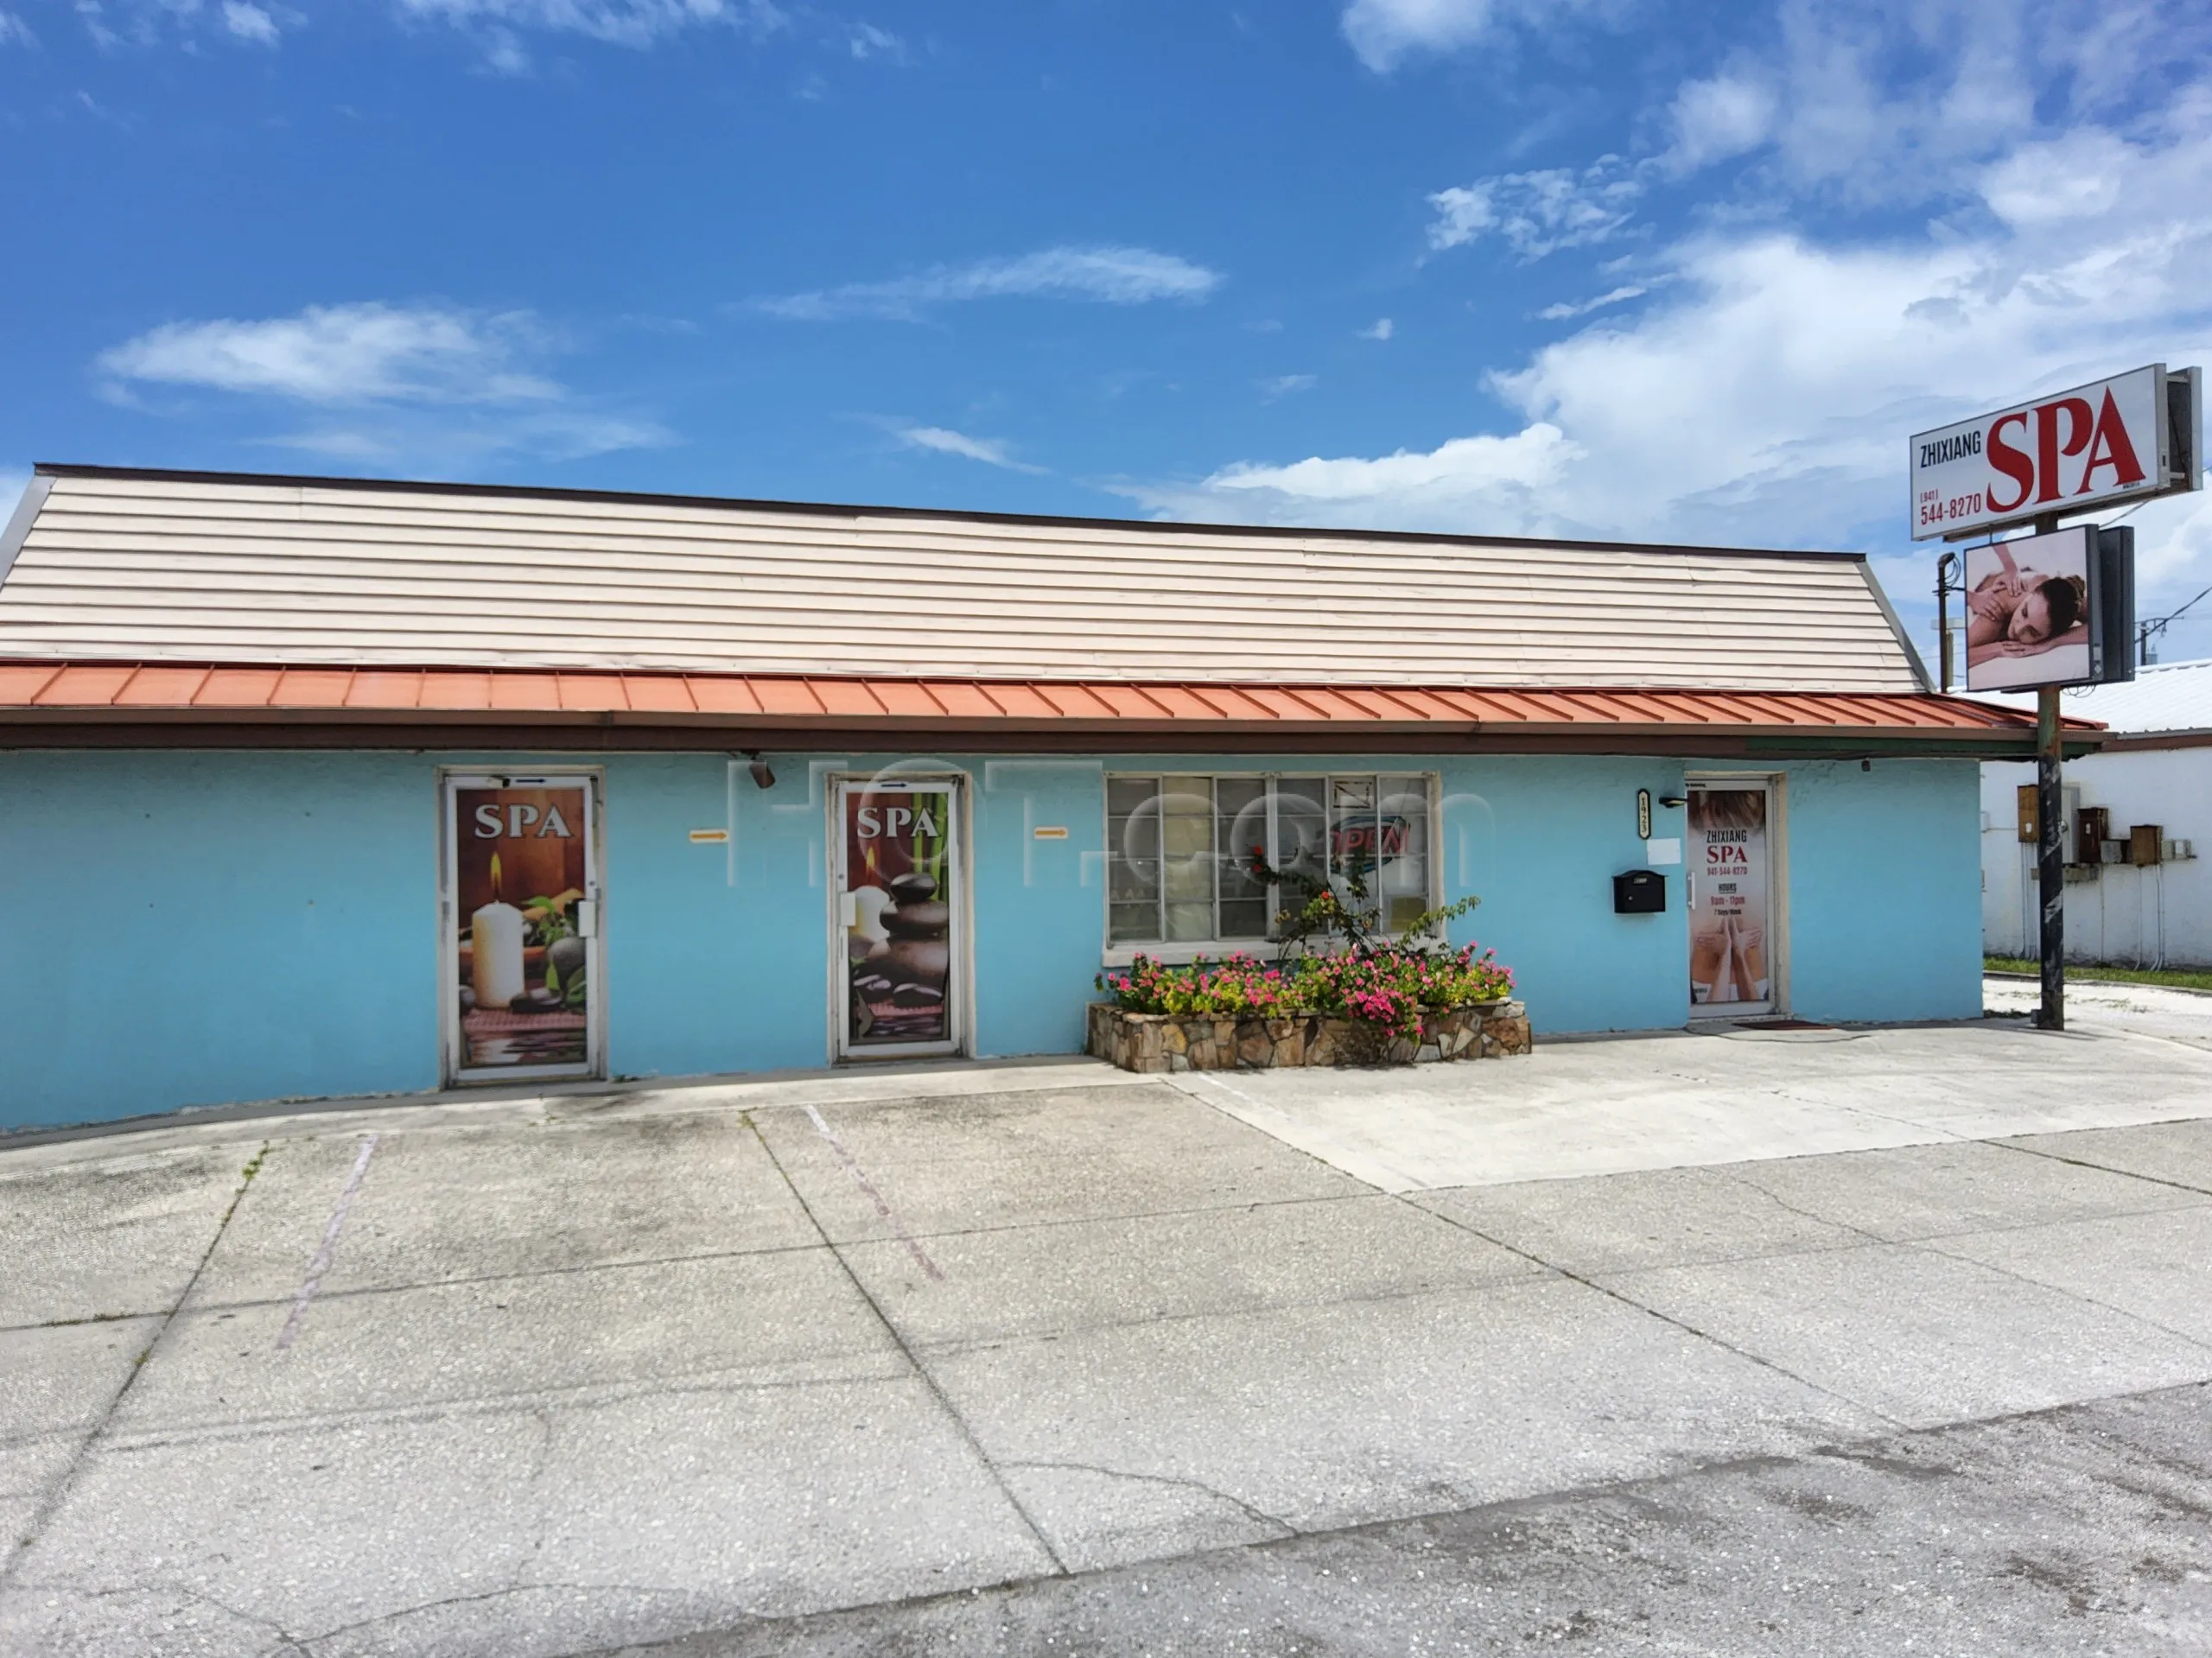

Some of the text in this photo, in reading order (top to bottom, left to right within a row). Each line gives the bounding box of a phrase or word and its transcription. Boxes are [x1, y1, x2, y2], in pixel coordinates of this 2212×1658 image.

[1920, 385, 2146, 513] ZHIXIANG SPA
[1920, 488, 1938, 504] (941)
[1921, 492, 1981, 525] 544-8270
[474, 804, 572, 839] SPA
[856, 806, 939, 839] SPA
[1707, 829, 1747, 843] ZHIXIANG
[1707, 845, 1748, 864] SPA
[1707, 867, 1748, 876] 941-544-8270
[1718, 883, 1737, 893] HOURS
